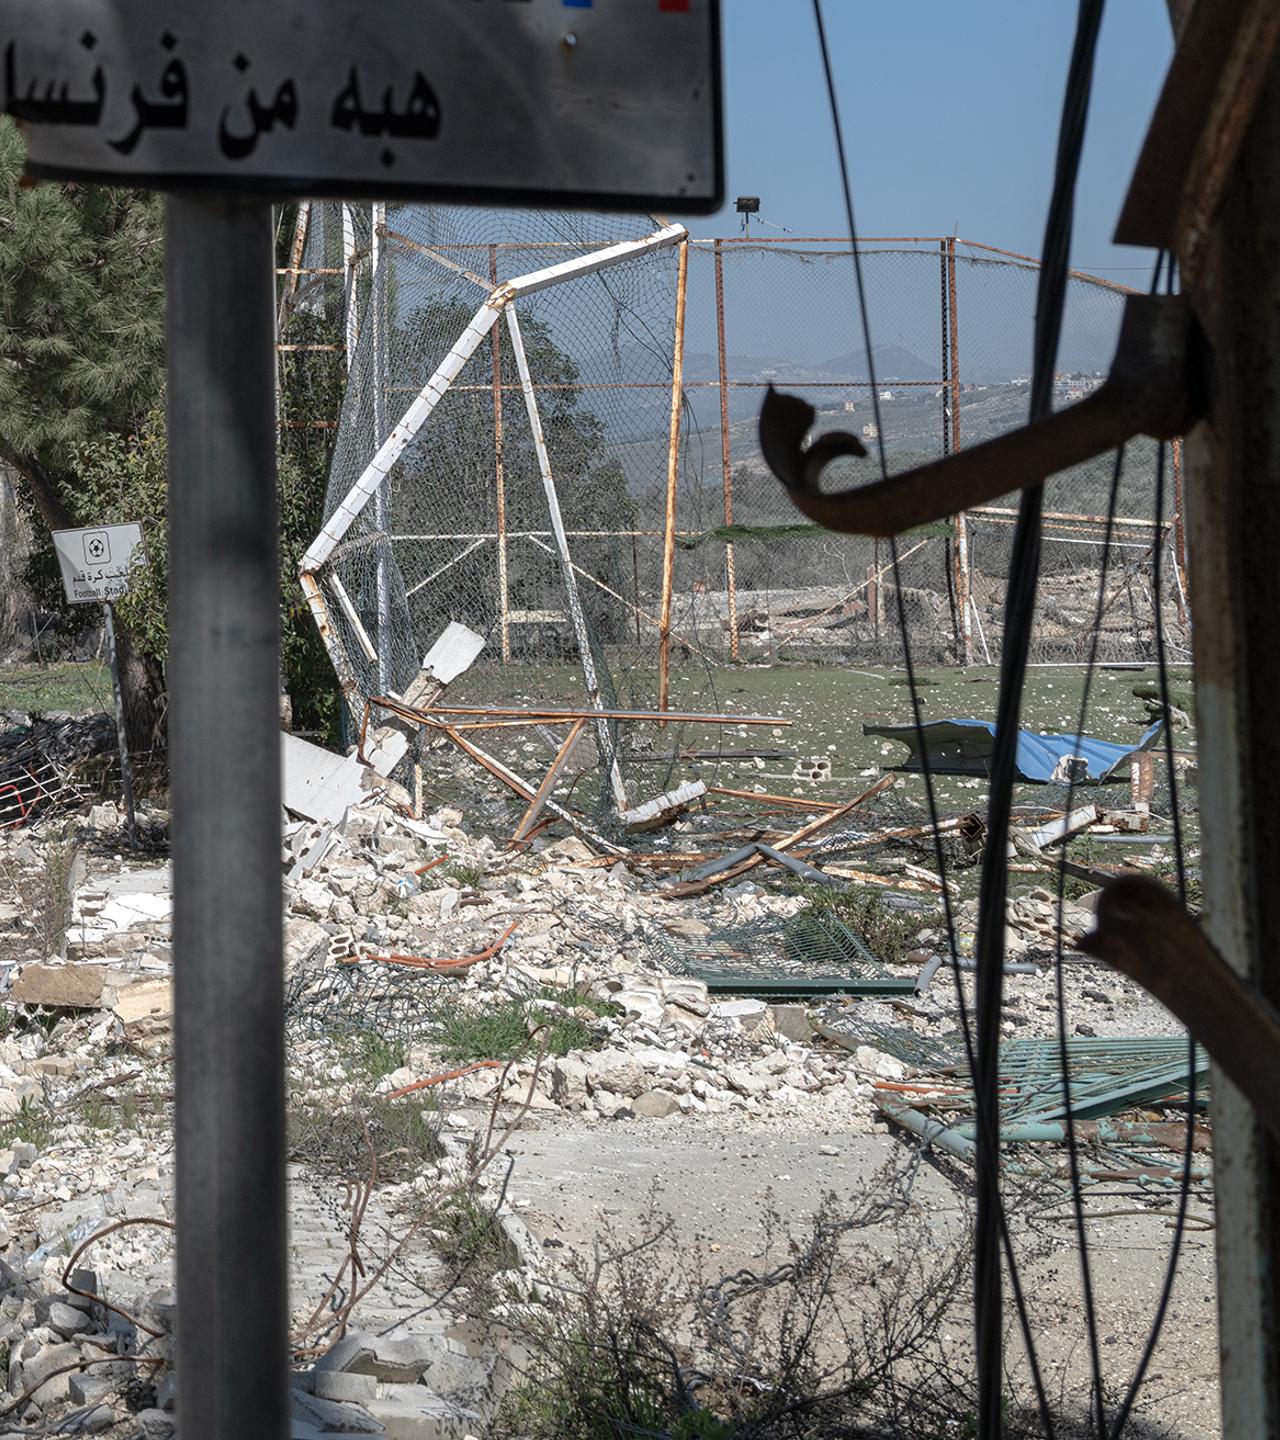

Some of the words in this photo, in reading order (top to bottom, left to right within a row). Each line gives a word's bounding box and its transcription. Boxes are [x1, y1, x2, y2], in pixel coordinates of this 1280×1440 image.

[0, 29, 192, 158] فرنسا
[216, 52, 301, 163] من
[74, 587, 101, 598] Football
